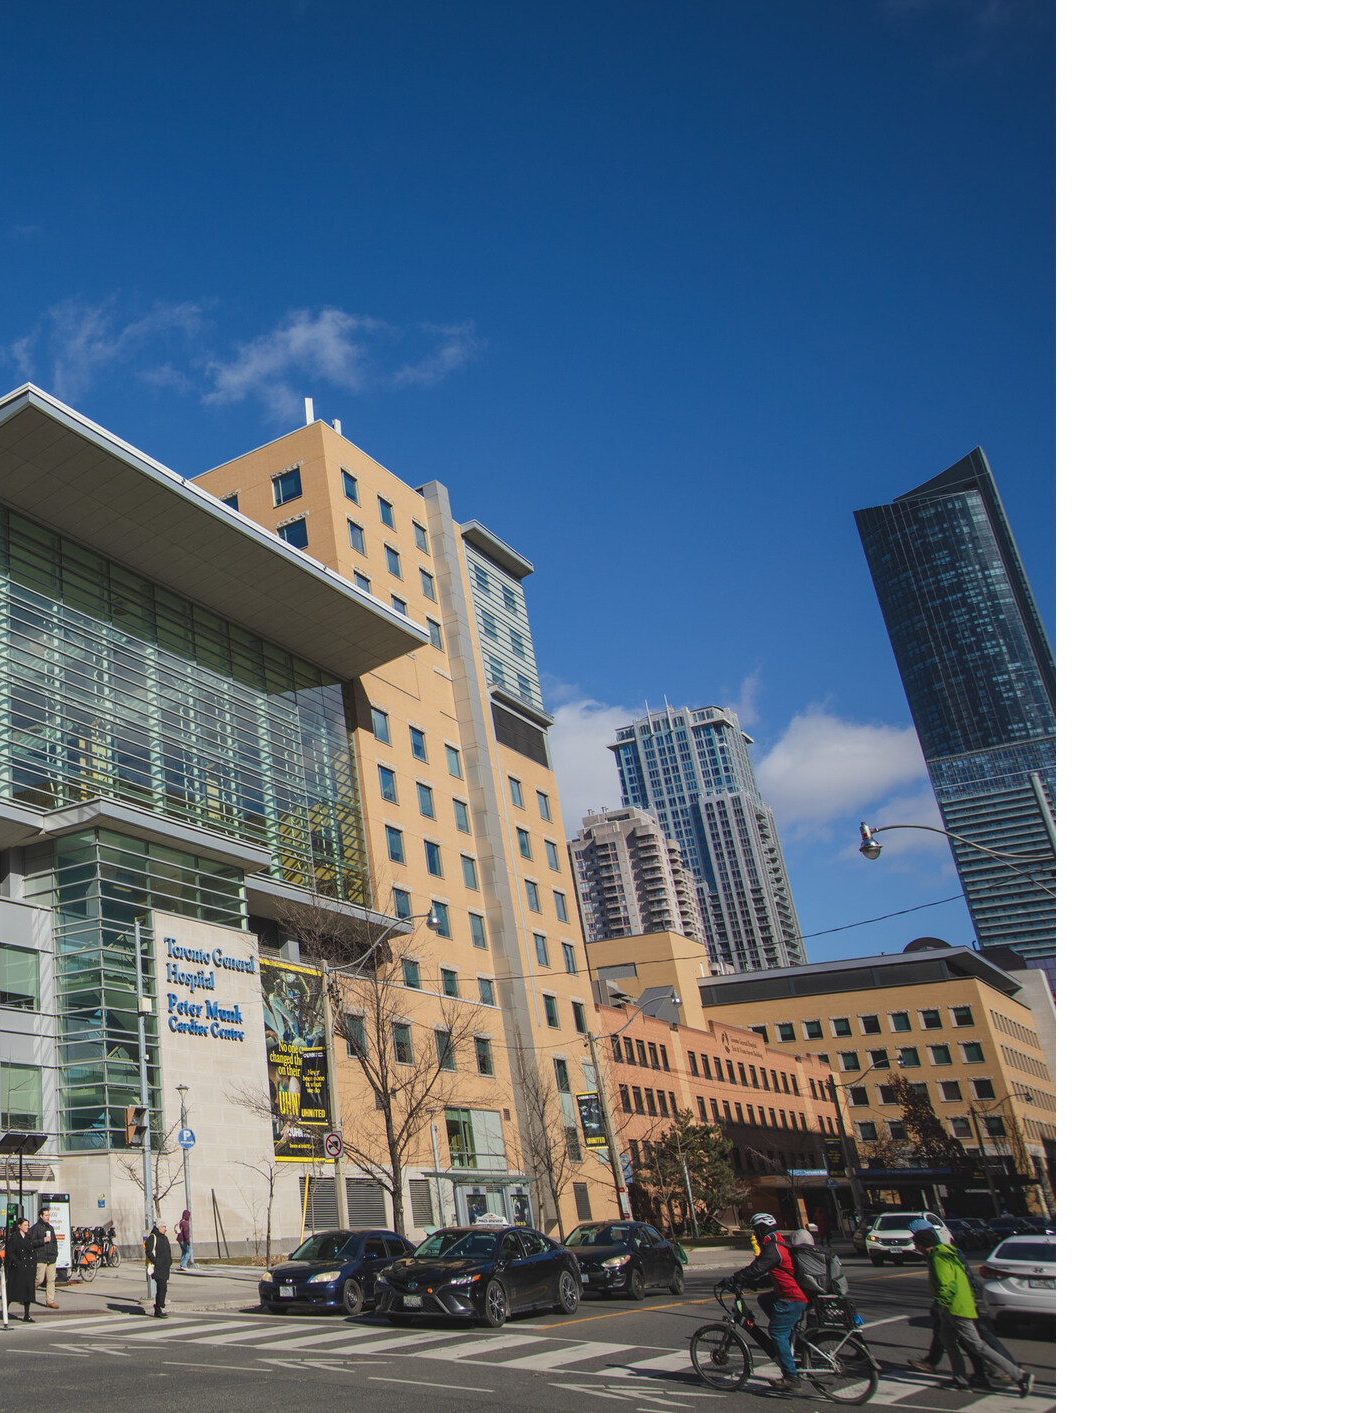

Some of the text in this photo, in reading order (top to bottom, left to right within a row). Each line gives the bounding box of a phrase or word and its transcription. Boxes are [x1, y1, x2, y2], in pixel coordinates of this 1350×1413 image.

[163, 936, 255, 974] Toronto General
[166, 962, 215, 993] Hospital
[167, 993, 244, 1024] Peter Munk
[168, 1015, 246, 1042] Cardiac Centre
[278, 1040, 287, 1053] No
[287, 1044, 299, 1054] one
[270, 1050, 294, 1067] changed
[278, 1064, 301, 1077] on their
[301, 1108, 326, 1118] UHNITED
[183, 1130, 191, 1141] P
